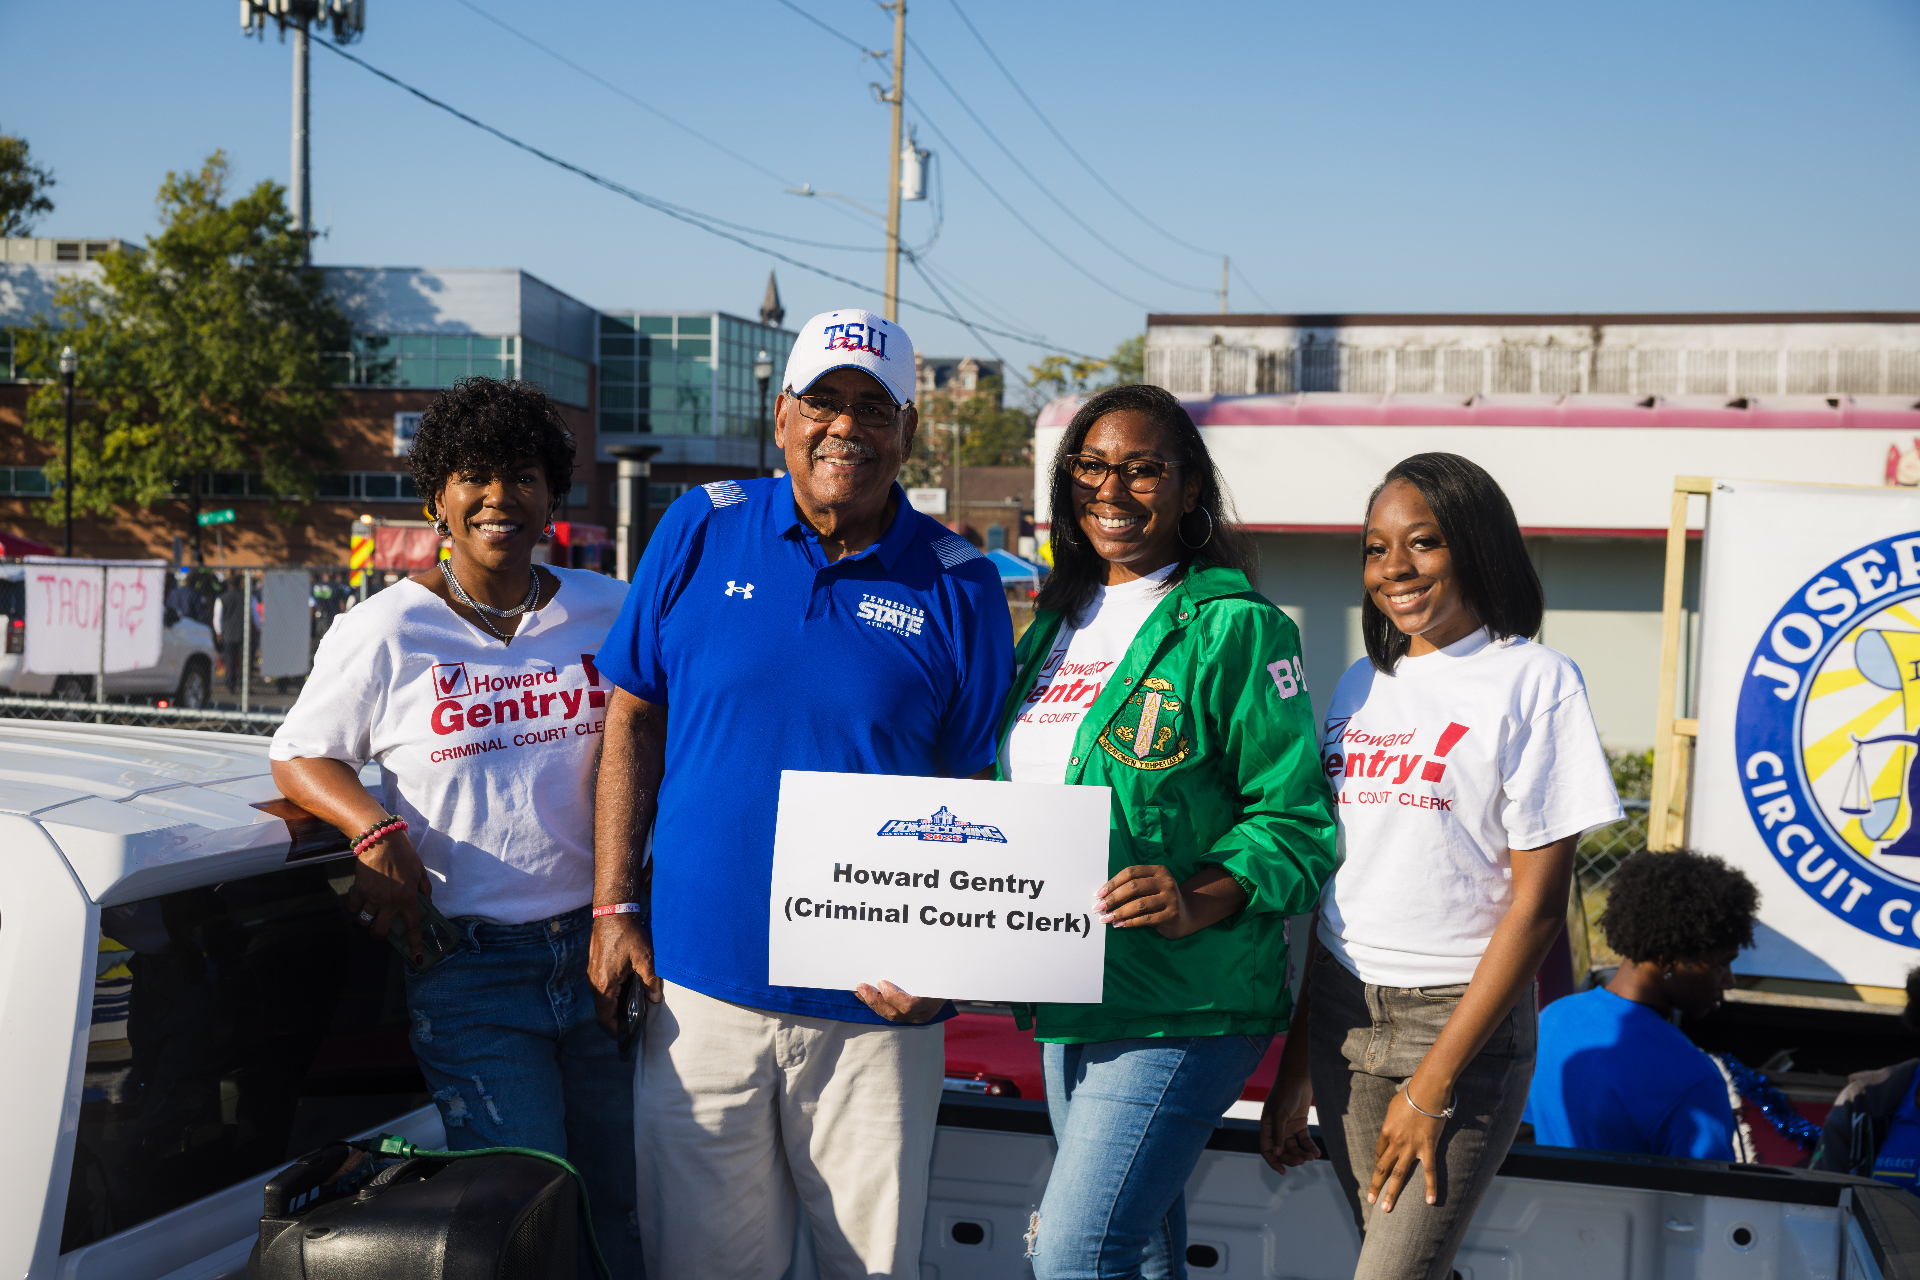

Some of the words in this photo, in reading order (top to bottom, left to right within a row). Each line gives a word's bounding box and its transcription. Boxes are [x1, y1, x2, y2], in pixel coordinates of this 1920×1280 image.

[824, 323, 887, 357] TSU
[829, 337, 884, 361] Tigers
[857, 601, 924, 635] STATE
[431, 654, 606, 736] Gentry!
[474, 667, 558, 694] Howard
[1024, 679, 1104, 709] entry
[1039, 713, 1080, 723] COURT
[430, 738, 507, 763] CRIMINAL
[513, 727, 567, 747] COURT
[575, 721, 605, 736] CLE
[1338, 728, 1417, 747] Howard
[1398, 793, 1452, 811] CLERK
[883, 821, 1004, 839] HOMECOMING
[923, 833, 963, 842] 2025
[1746, 751, 1873, 913] CIRCUIT
[833, 862, 940, 889] Howard
[949, 870, 1045, 900] Gentry
[784, 897, 909, 924] (Criminal
[919, 905, 996, 930] Court
[1006, 910, 1091, 939] Clerk)
